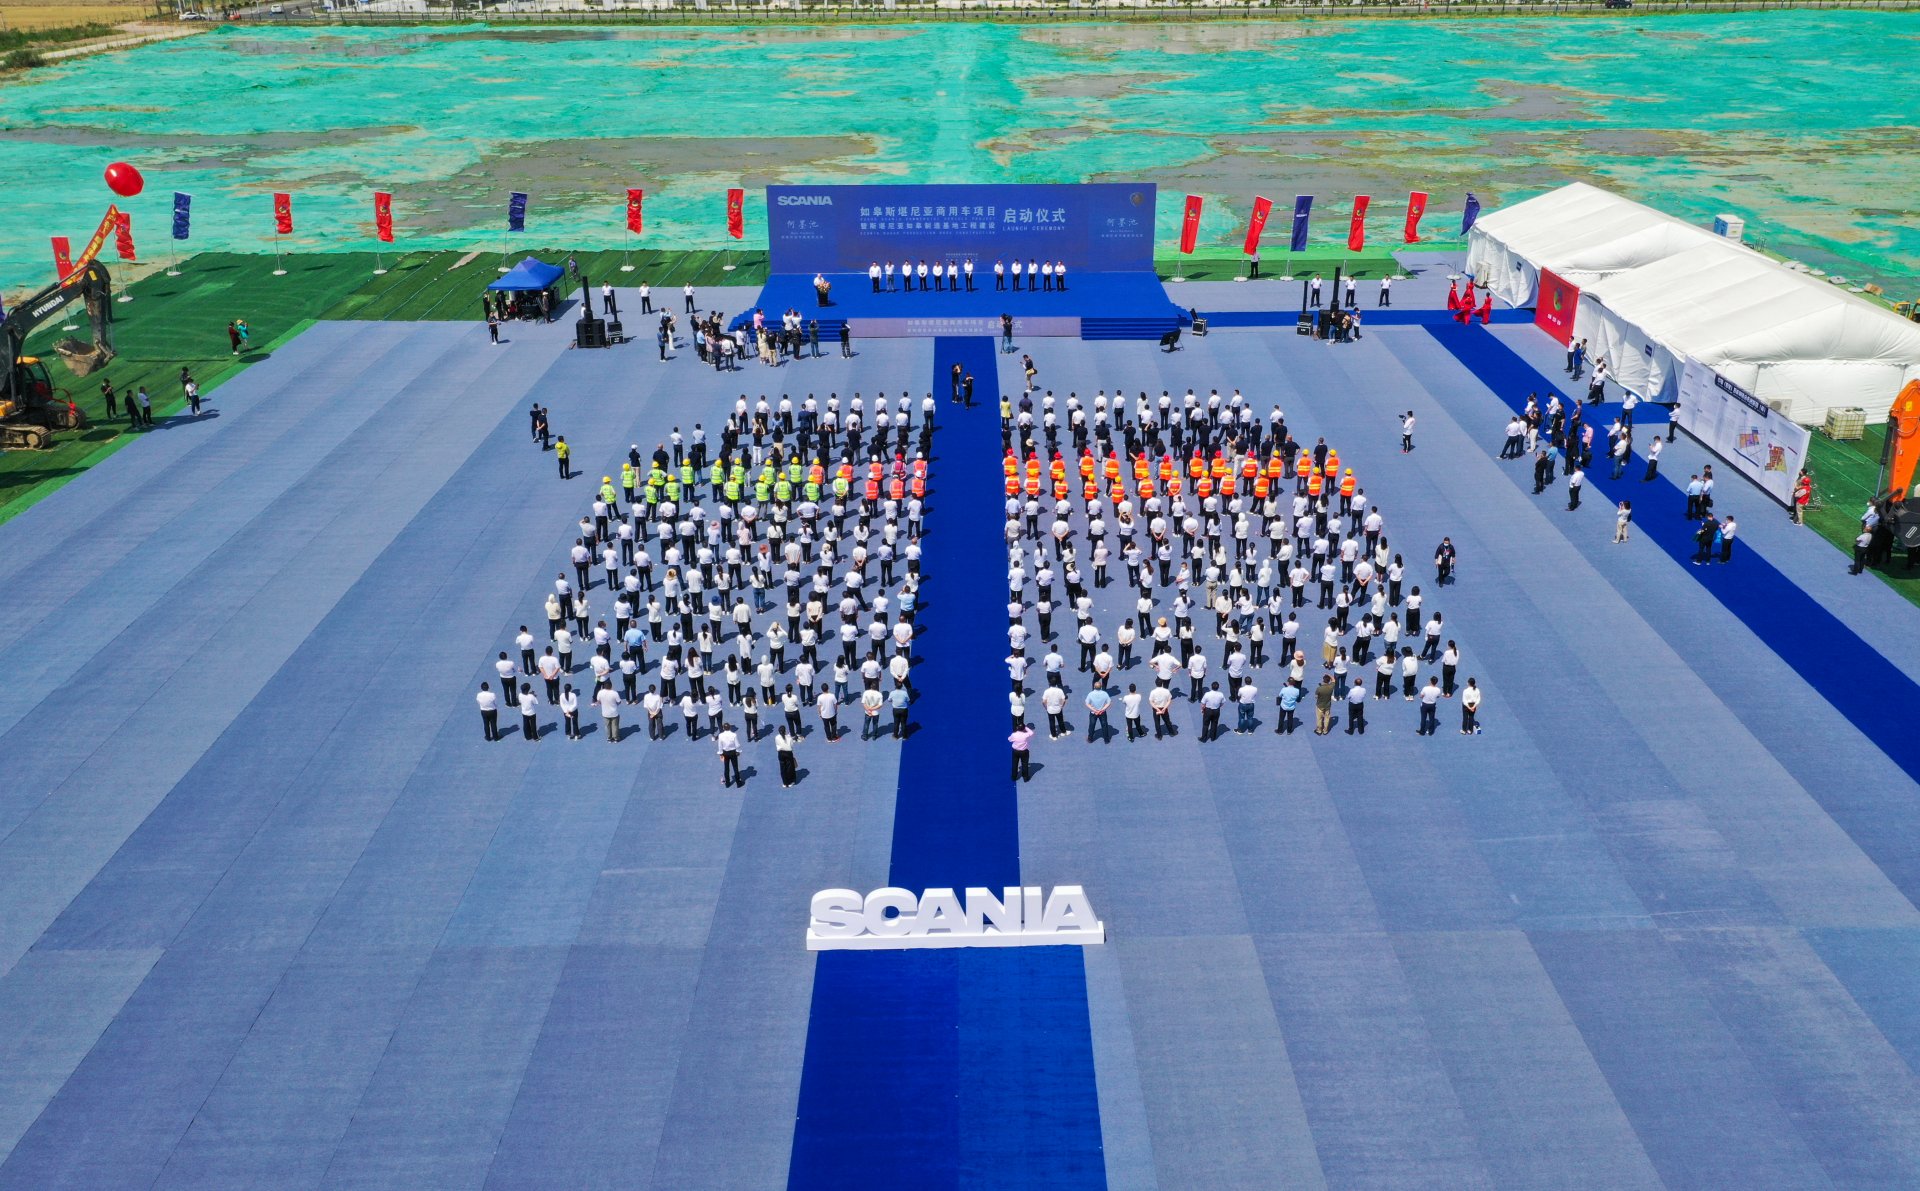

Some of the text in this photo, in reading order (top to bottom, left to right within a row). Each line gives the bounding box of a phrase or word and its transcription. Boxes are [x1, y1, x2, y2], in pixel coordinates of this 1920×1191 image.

[777, 195, 833, 206] SCANIA
[860, 206, 996, 217] 如皋斯堪尼亚商用车项目
[1003, 207, 1066, 223] 启动仪式
[32, 295, 65, 318] HYUNDAI
[809, 885, 1100, 938] SCANIA
